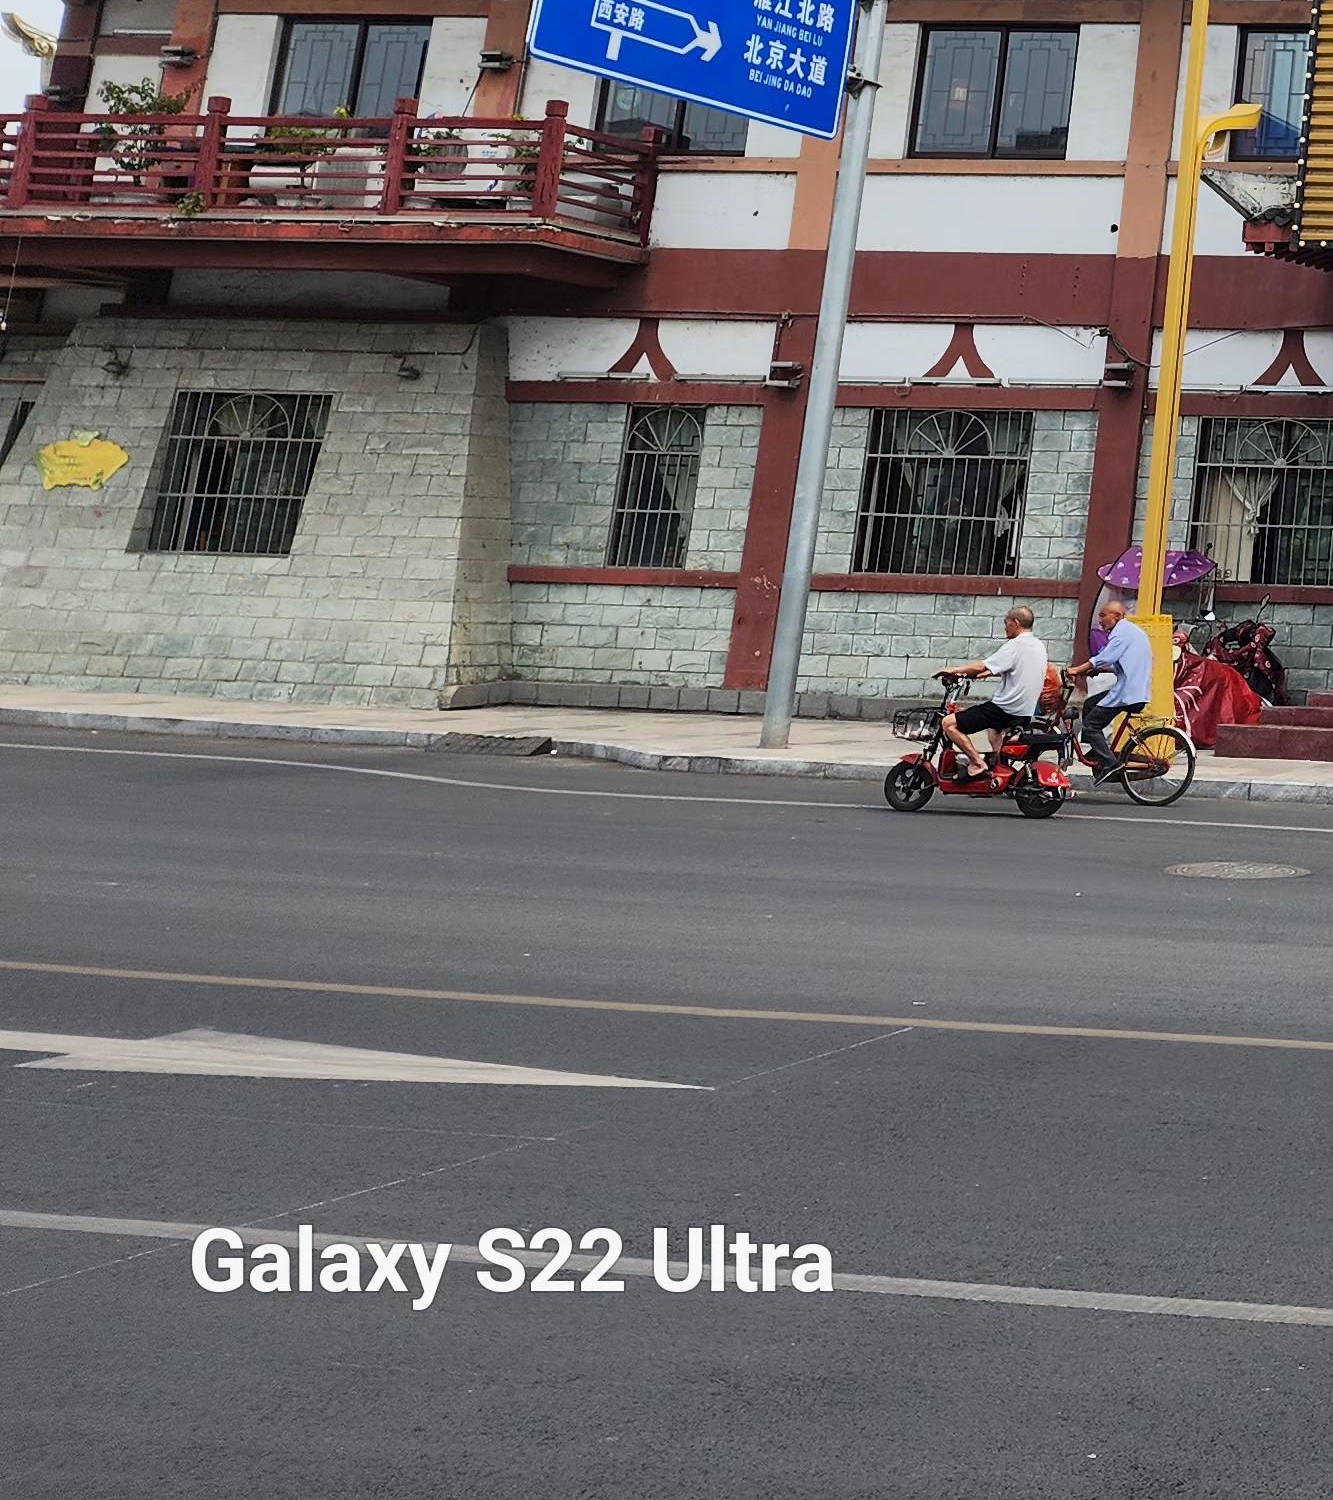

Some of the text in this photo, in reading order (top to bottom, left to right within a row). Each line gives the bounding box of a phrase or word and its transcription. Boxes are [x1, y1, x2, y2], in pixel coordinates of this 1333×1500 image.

[756, 14, 823, 48] YAN JIANG BEI LU
[743, 33, 828, 86] 北京大道
[748, 68, 812, 98] BEI JING DA DAO
